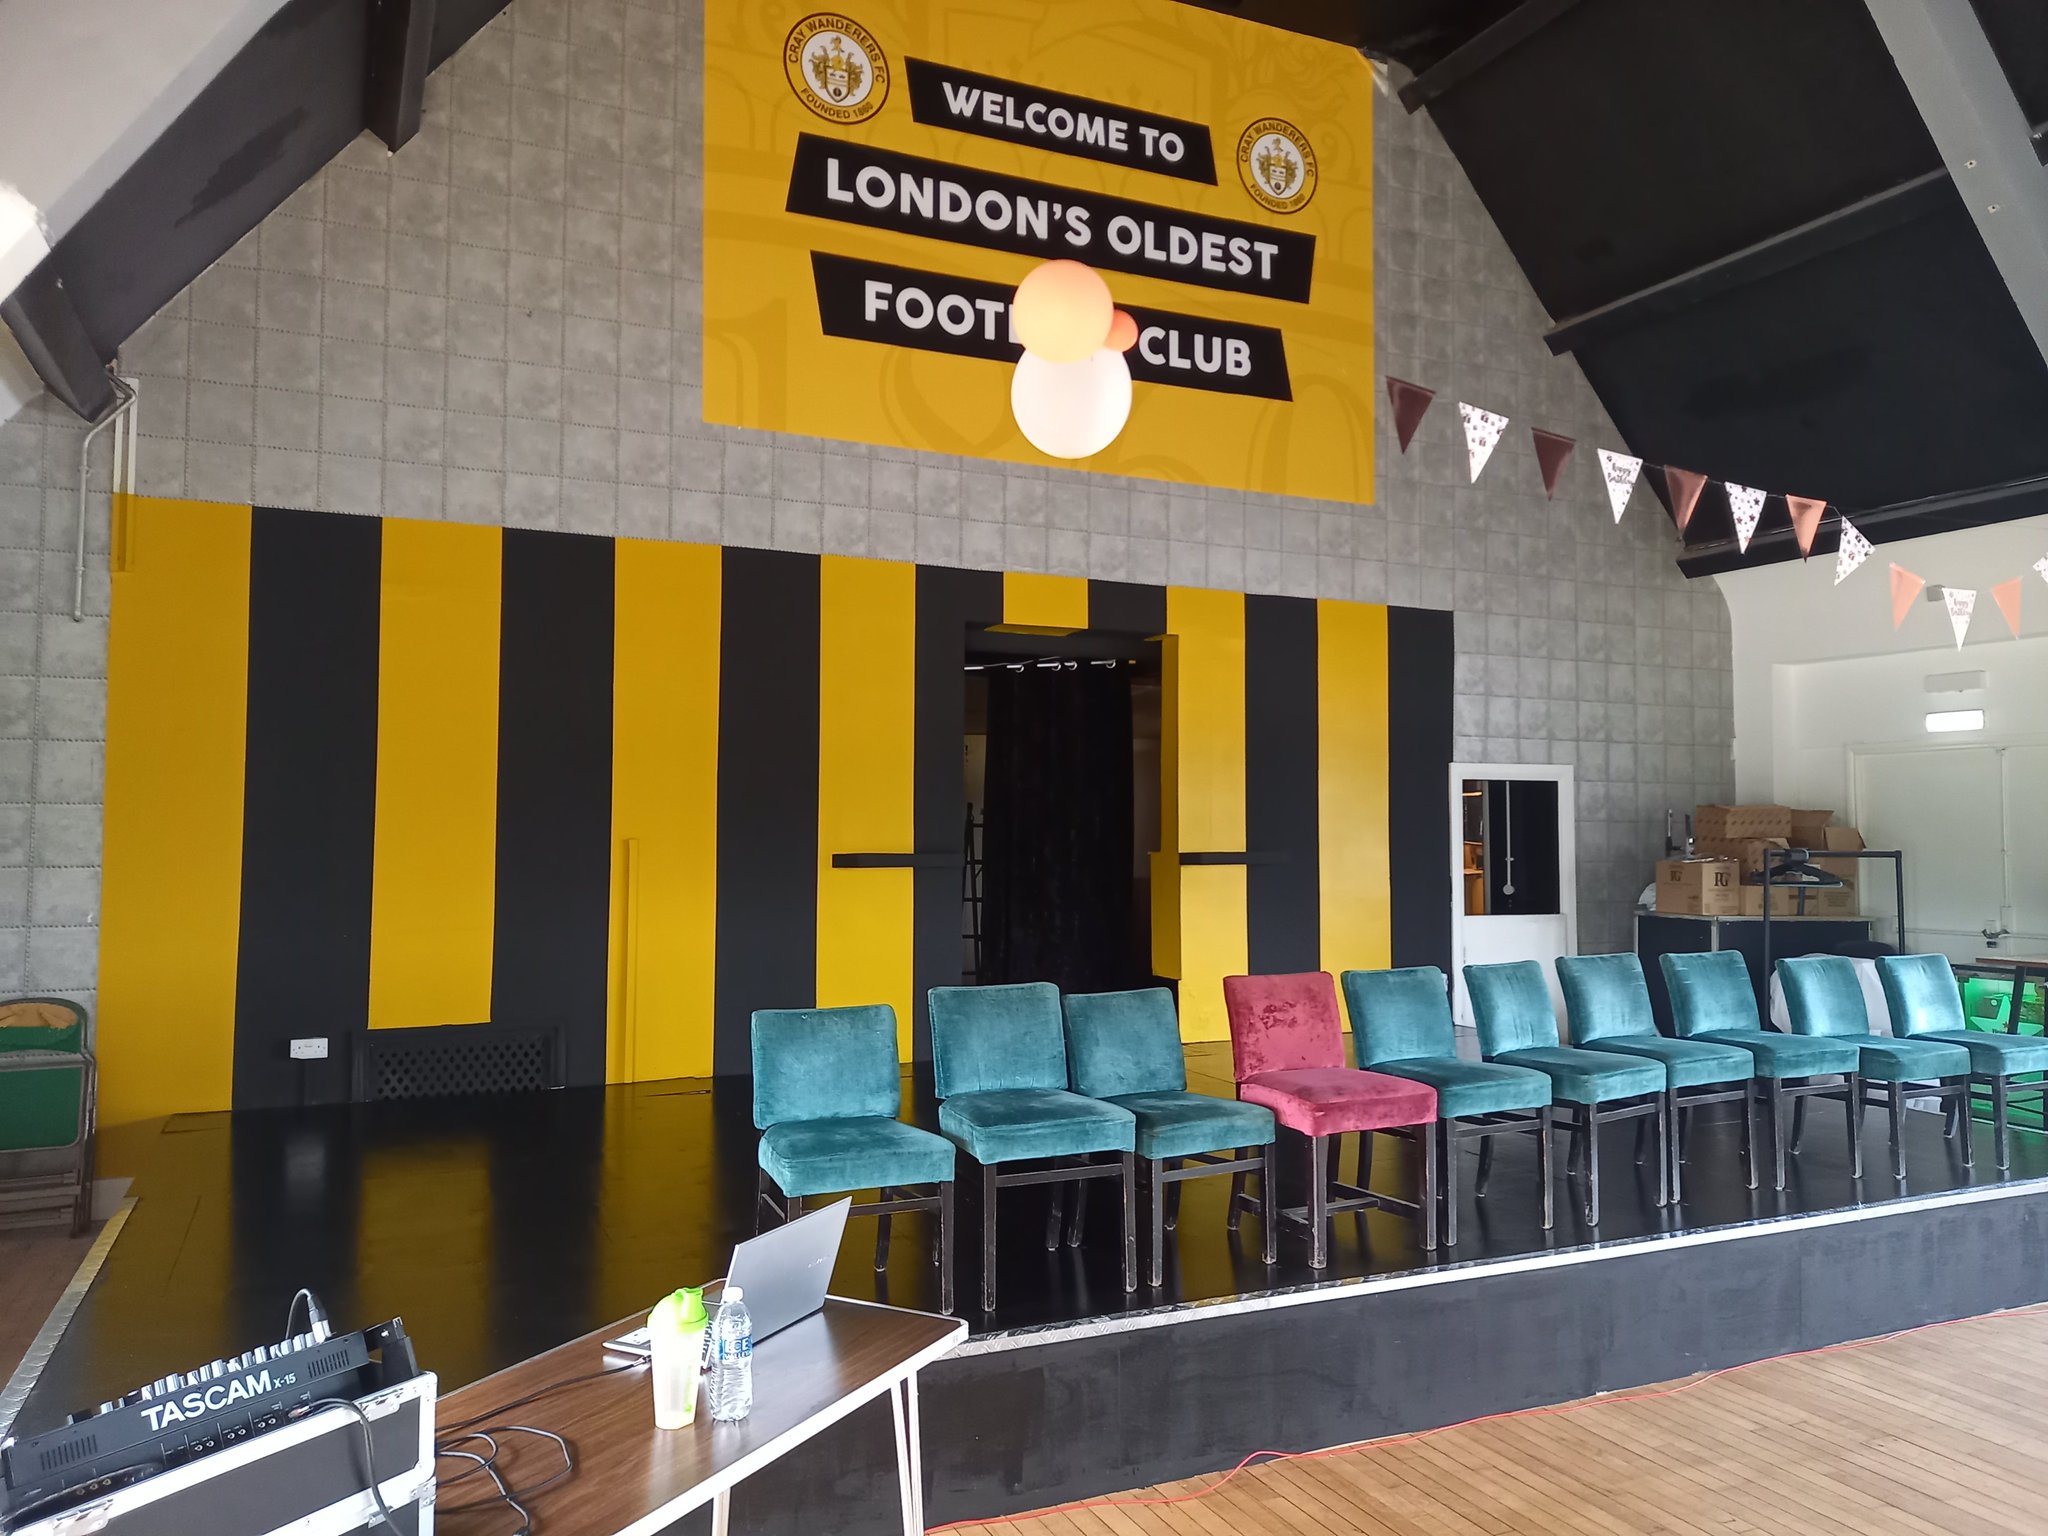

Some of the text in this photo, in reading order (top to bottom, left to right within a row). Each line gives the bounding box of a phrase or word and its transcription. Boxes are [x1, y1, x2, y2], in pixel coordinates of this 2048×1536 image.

[788, 17, 886, 84] CRAY WANDERERS FC
[800, 87, 851, 119] FOUNDED
[941, 81, 1185, 162] WELCOME TO
[1240, 132, 1254, 163] CRAY
[827, 157, 1279, 280] LONDON'S OLDEST
[864, 279, 1252, 377] FOOT CLUB
[140, 1369, 272, 1432] TASCAM
